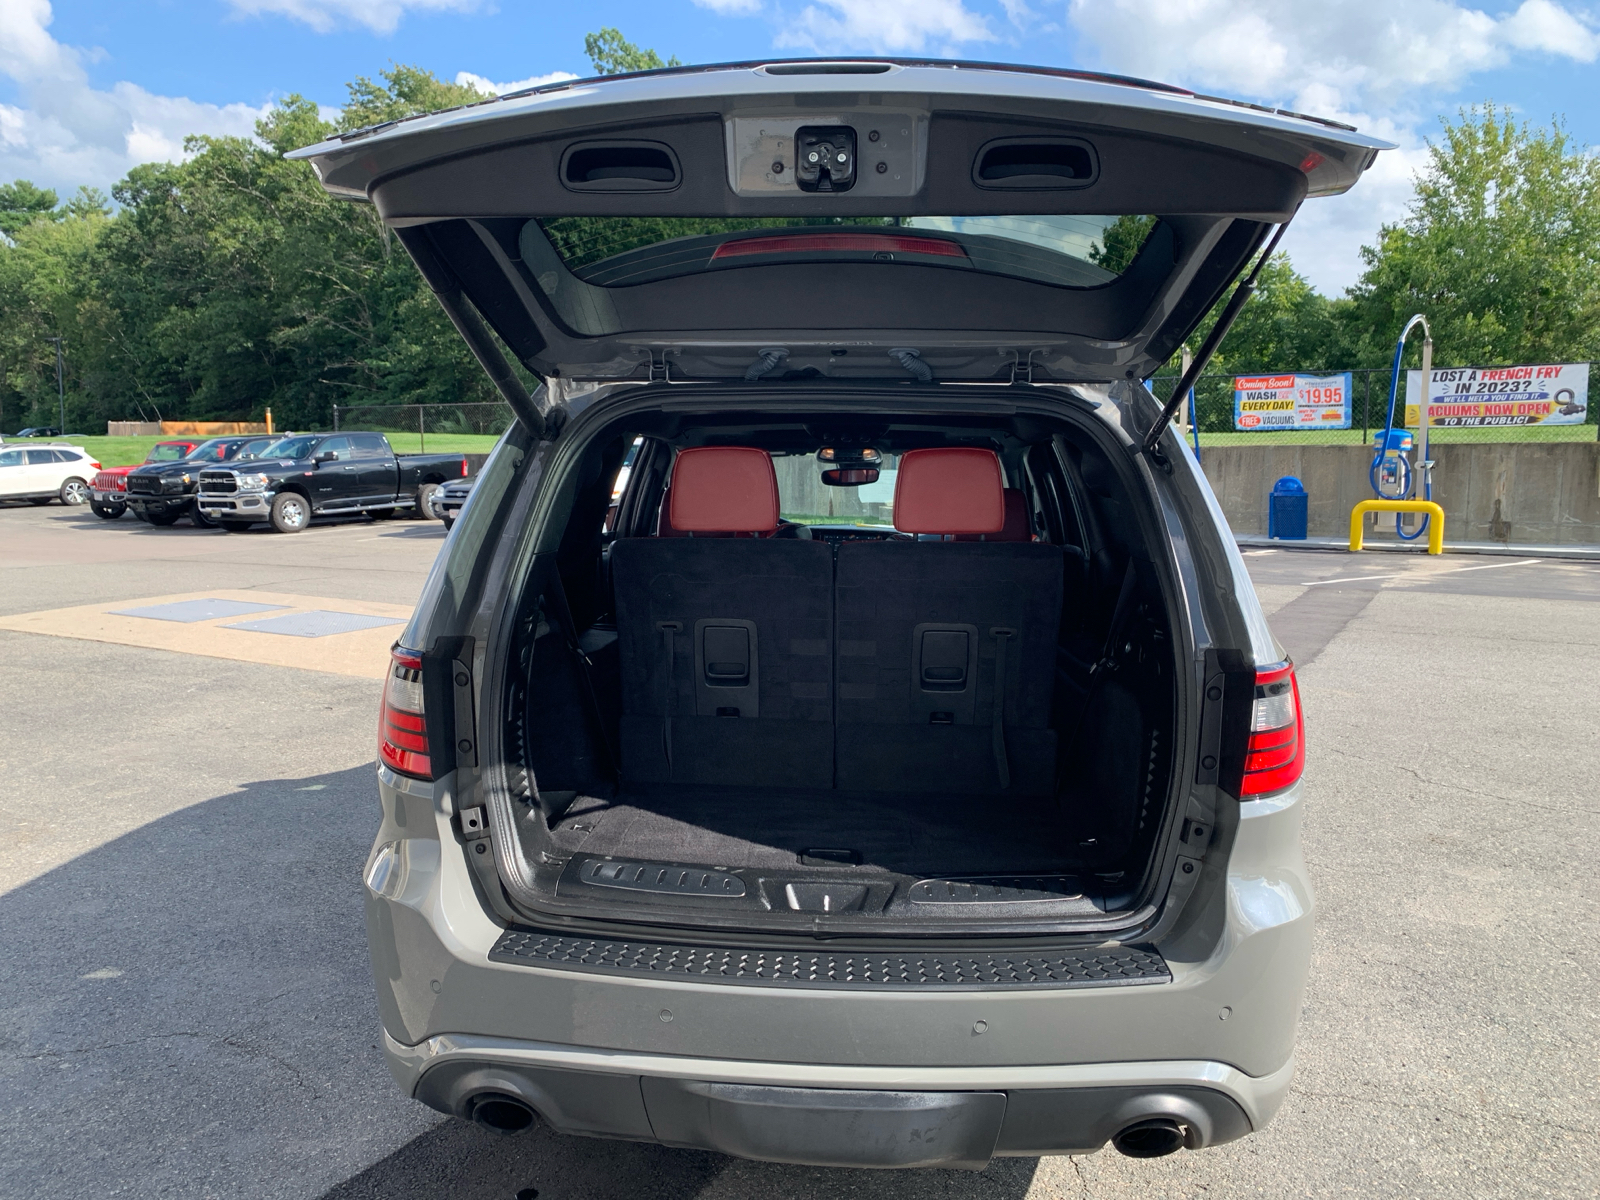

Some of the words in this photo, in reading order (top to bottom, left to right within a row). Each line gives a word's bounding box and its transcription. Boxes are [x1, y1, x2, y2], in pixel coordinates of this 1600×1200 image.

[1432, 370, 1466, 382] LOST
[1468, 371, 1477, 382] A
[1481, 368, 1533, 381] FRENCH
[1536, 366, 1563, 378] FRY
[1238, 380, 1267, 390] Coming
[1268, 376, 1294, 388] Soon!
[1455, 383, 1472, 394] IN
[1476, 380, 1532, 394] 2023?
[1247, 392, 1277, 400] WASH
[1242, 402, 1272, 410] EVERY
[1272, 400, 1294, 410] DAY!
[1428, 404, 1480, 416] ACUUMS
[1484, 404, 1514, 416] NOW
[1518, 402, 1550, 415] OPEN
[1242, 417, 1258, 426] FREE
[1262, 416, 1294, 424] VACUUMS
[1484, 416, 1529, 424] PUBLIC!
